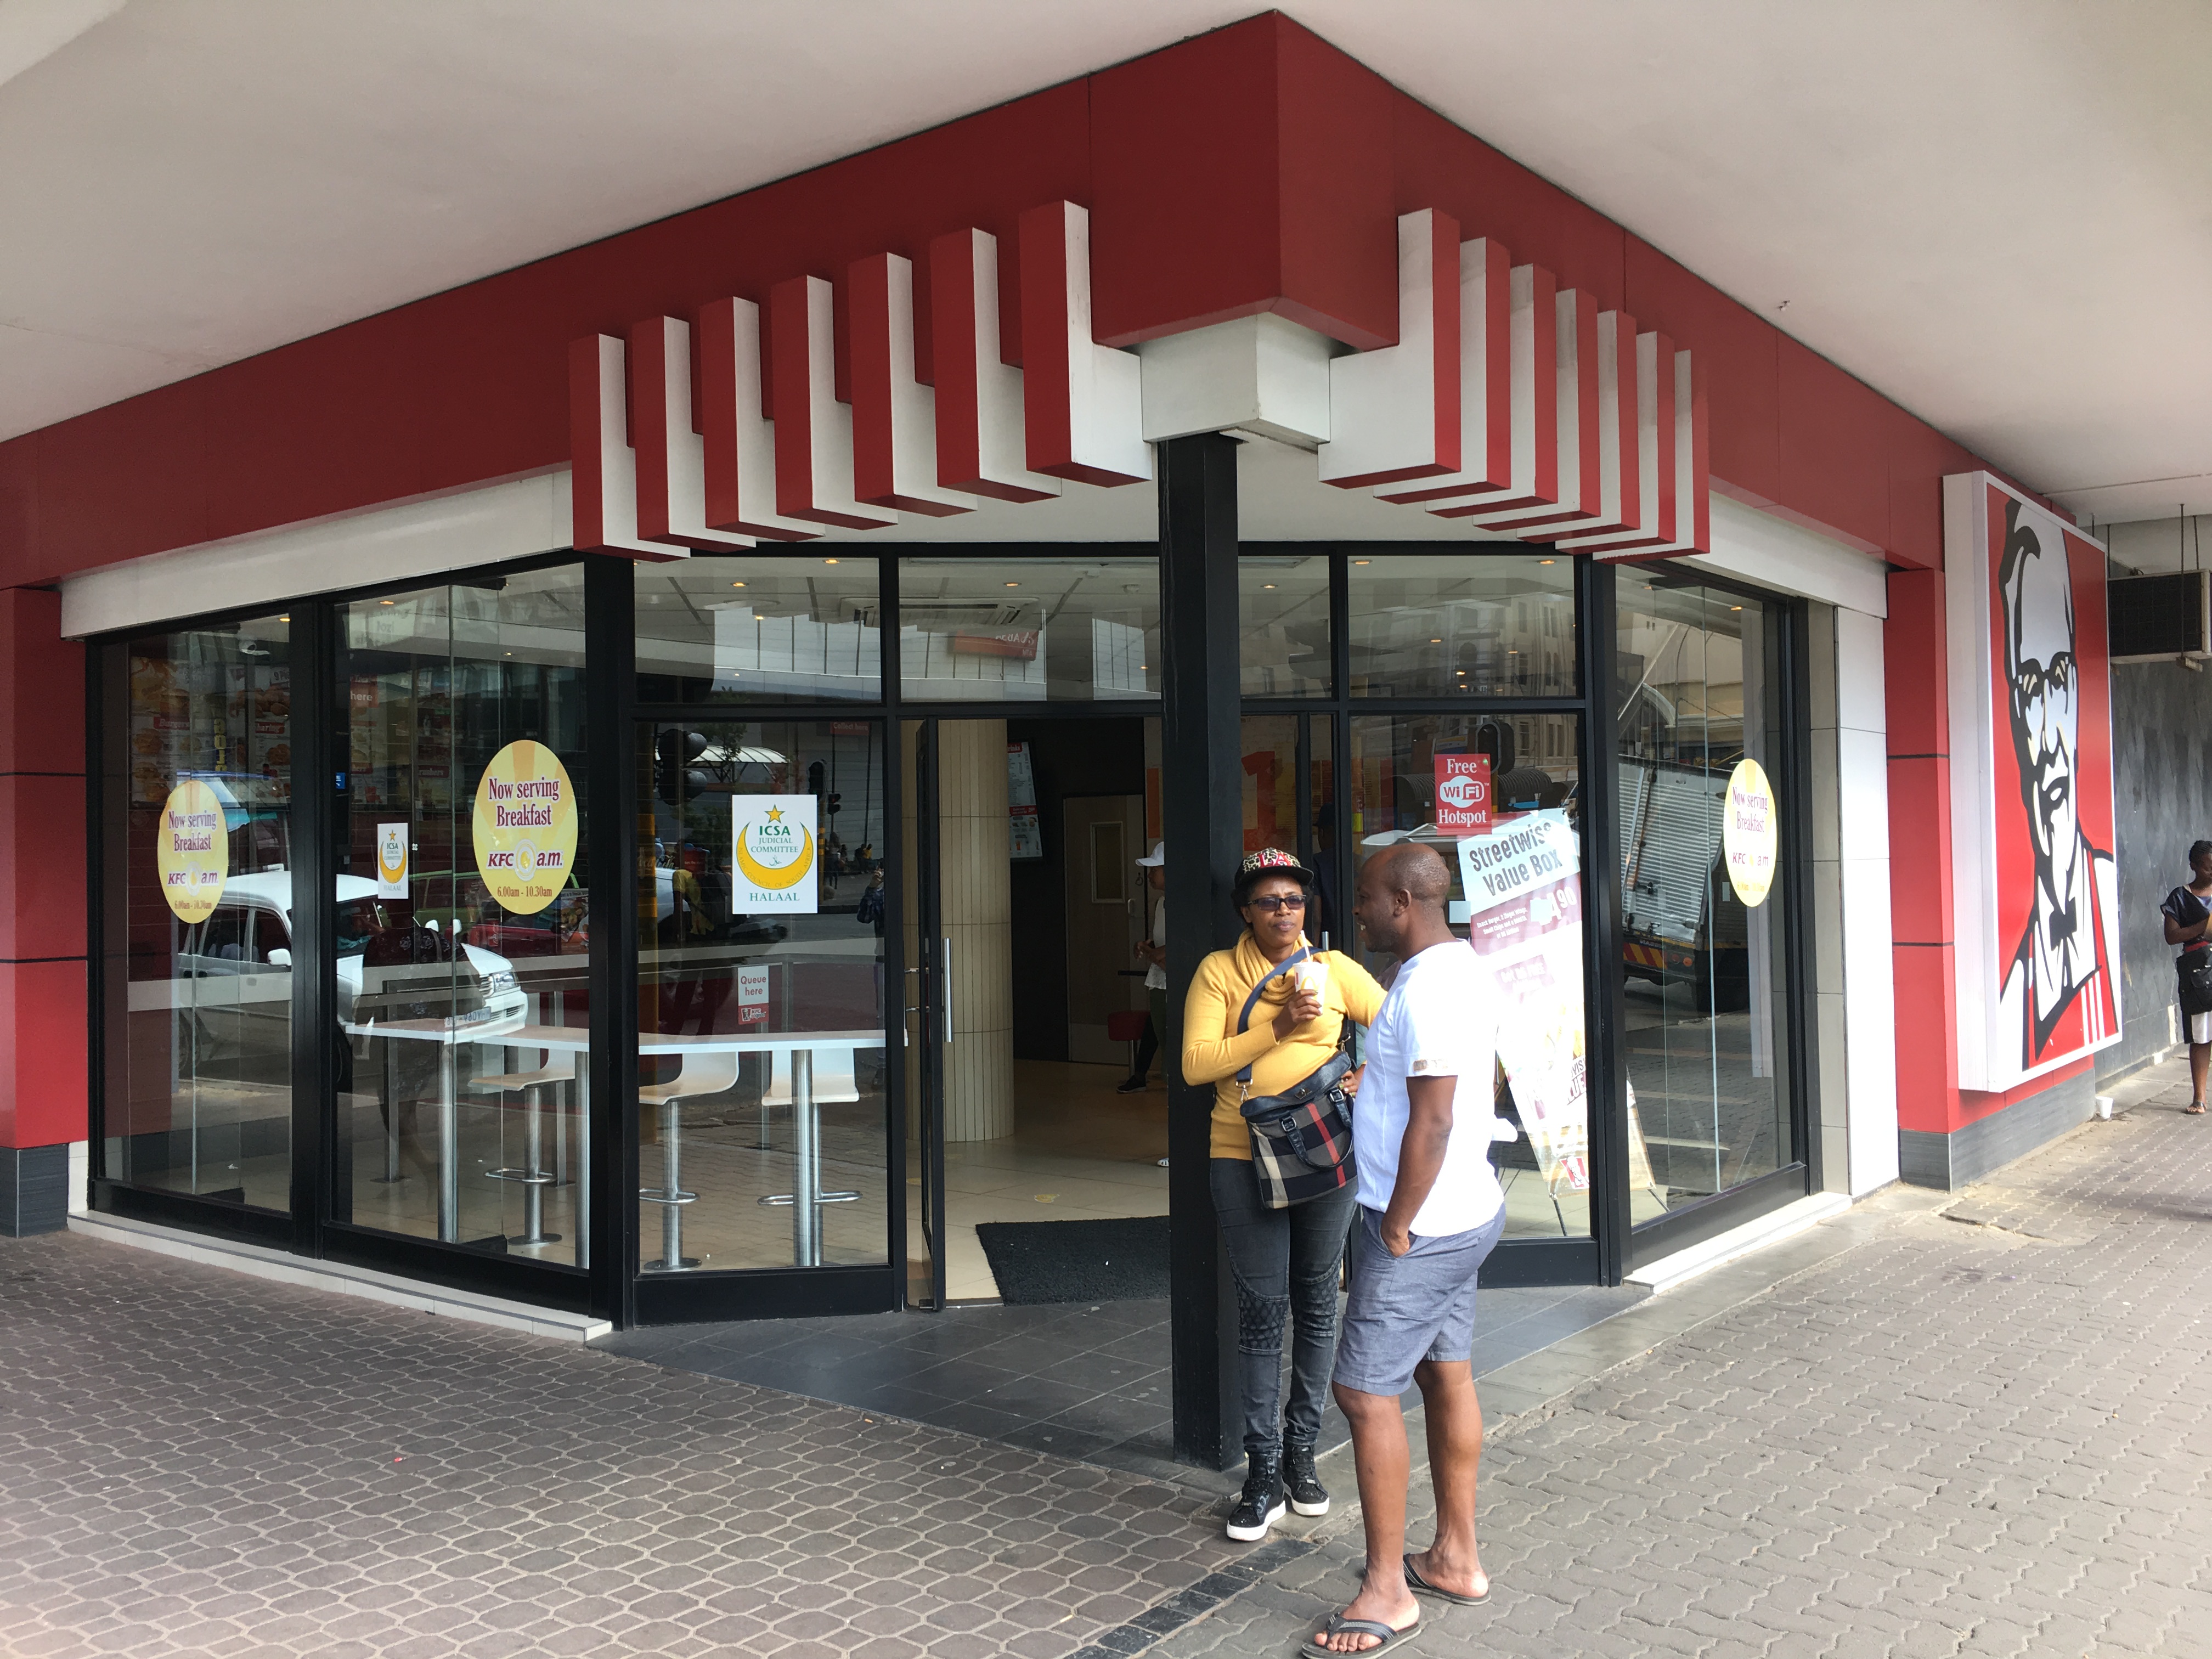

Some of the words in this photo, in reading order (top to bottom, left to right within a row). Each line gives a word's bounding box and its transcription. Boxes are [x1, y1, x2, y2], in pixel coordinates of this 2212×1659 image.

[855, 722, 868, 731] here
[1447, 759, 1477, 774] Free
[488, 778, 514, 800] Now
[516, 777, 560, 801] serving
[1733, 786, 1746, 805] Now
[1747, 793, 1768, 814] serving
[168, 811, 185, 829] Now
[187, 810, 217, 830] serving
[496, 804, 552, 827] Breakfast
[1438, 809, 1487, 827] Hotspot
[1737, 811, 1764, 833] Breakfast
[759, 826, 791, 836] ICSA
[174, 833, 211, 851] Breakfast
[759, 837, 793, 845] JUDICIAL
[488, 853, 514, 867] KFC
[1257, 853, 1293, 868] LA
[1733, 853, 1746, 865] KFC
[738, 847, 748, 870] ISLAMIC
[747, 871, 771, 887] COUNCIL
[786, 871, 804, 884] SOUTH
[1482, 862, 1530, 896] Value
[1530, 849, 1563, 877] Box
[168, 873, 186, 884] KFC
[497, 886, 520, 897] 6.00am
[526, 886, 552, 897] 10.30am
[749, 893, 800, 901] HALAAL
[741, 975, 766, 985] Queue
[745, 987, 763, 996] here
